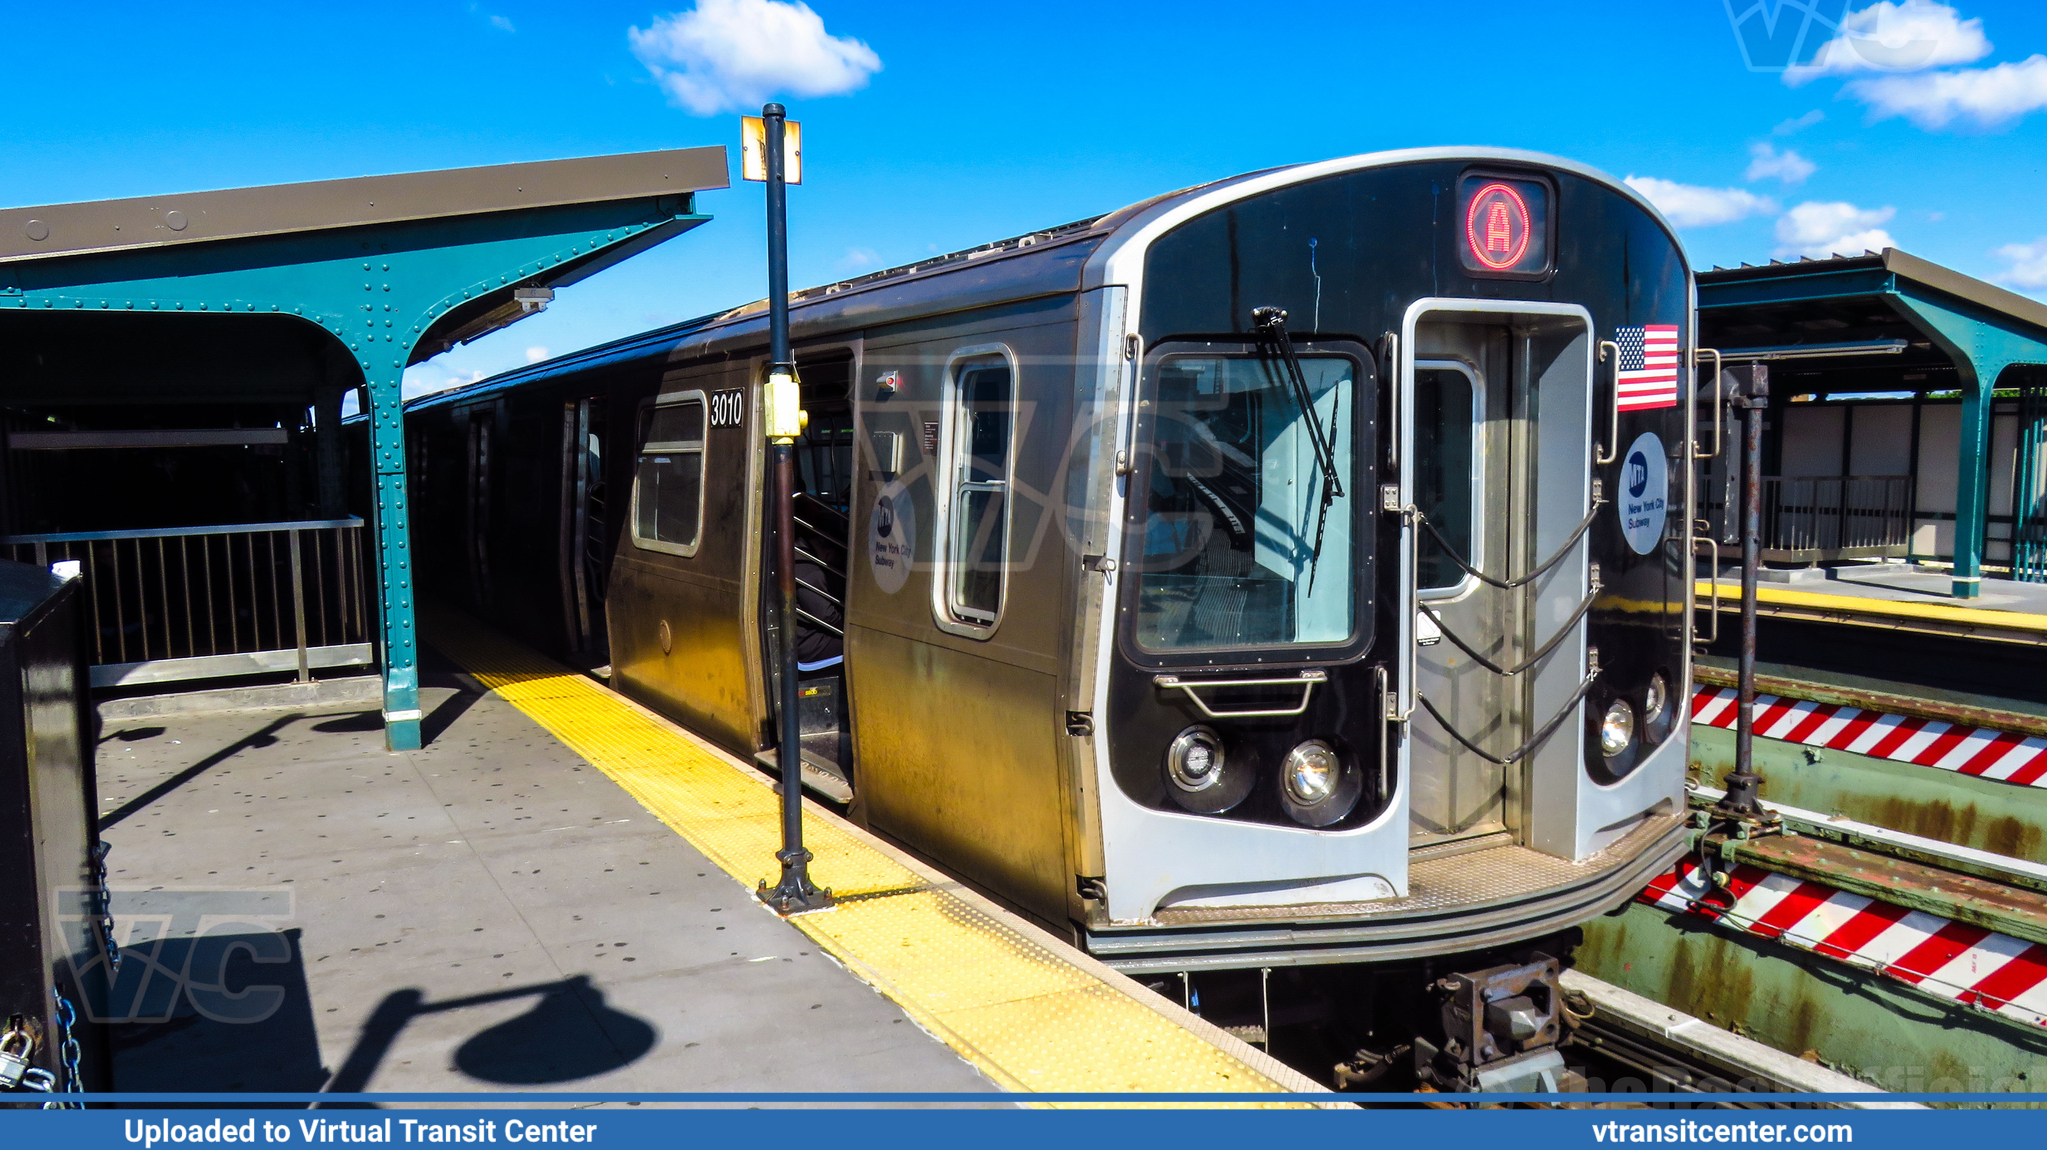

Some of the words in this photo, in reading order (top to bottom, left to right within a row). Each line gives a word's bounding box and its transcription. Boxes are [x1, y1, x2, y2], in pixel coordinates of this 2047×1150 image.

[1487, 201, 1510, 252] A
[711, 391, 743, 426] 3010
[1628, 463, 1645, 489] MTA
[878, 505, 891, 527] MTA
[1628, 503, 1642, 515] New
[1643, 500, 1655, 512] York
[1656, 498, 1664, 510] City
[1629, 518, 1650, 529] Subway
[876, 541, 887, 553] New
[888, 542, 900, 555] York
[901, 544, 911, 558] City
[875, 555, 894, 569] Subway
